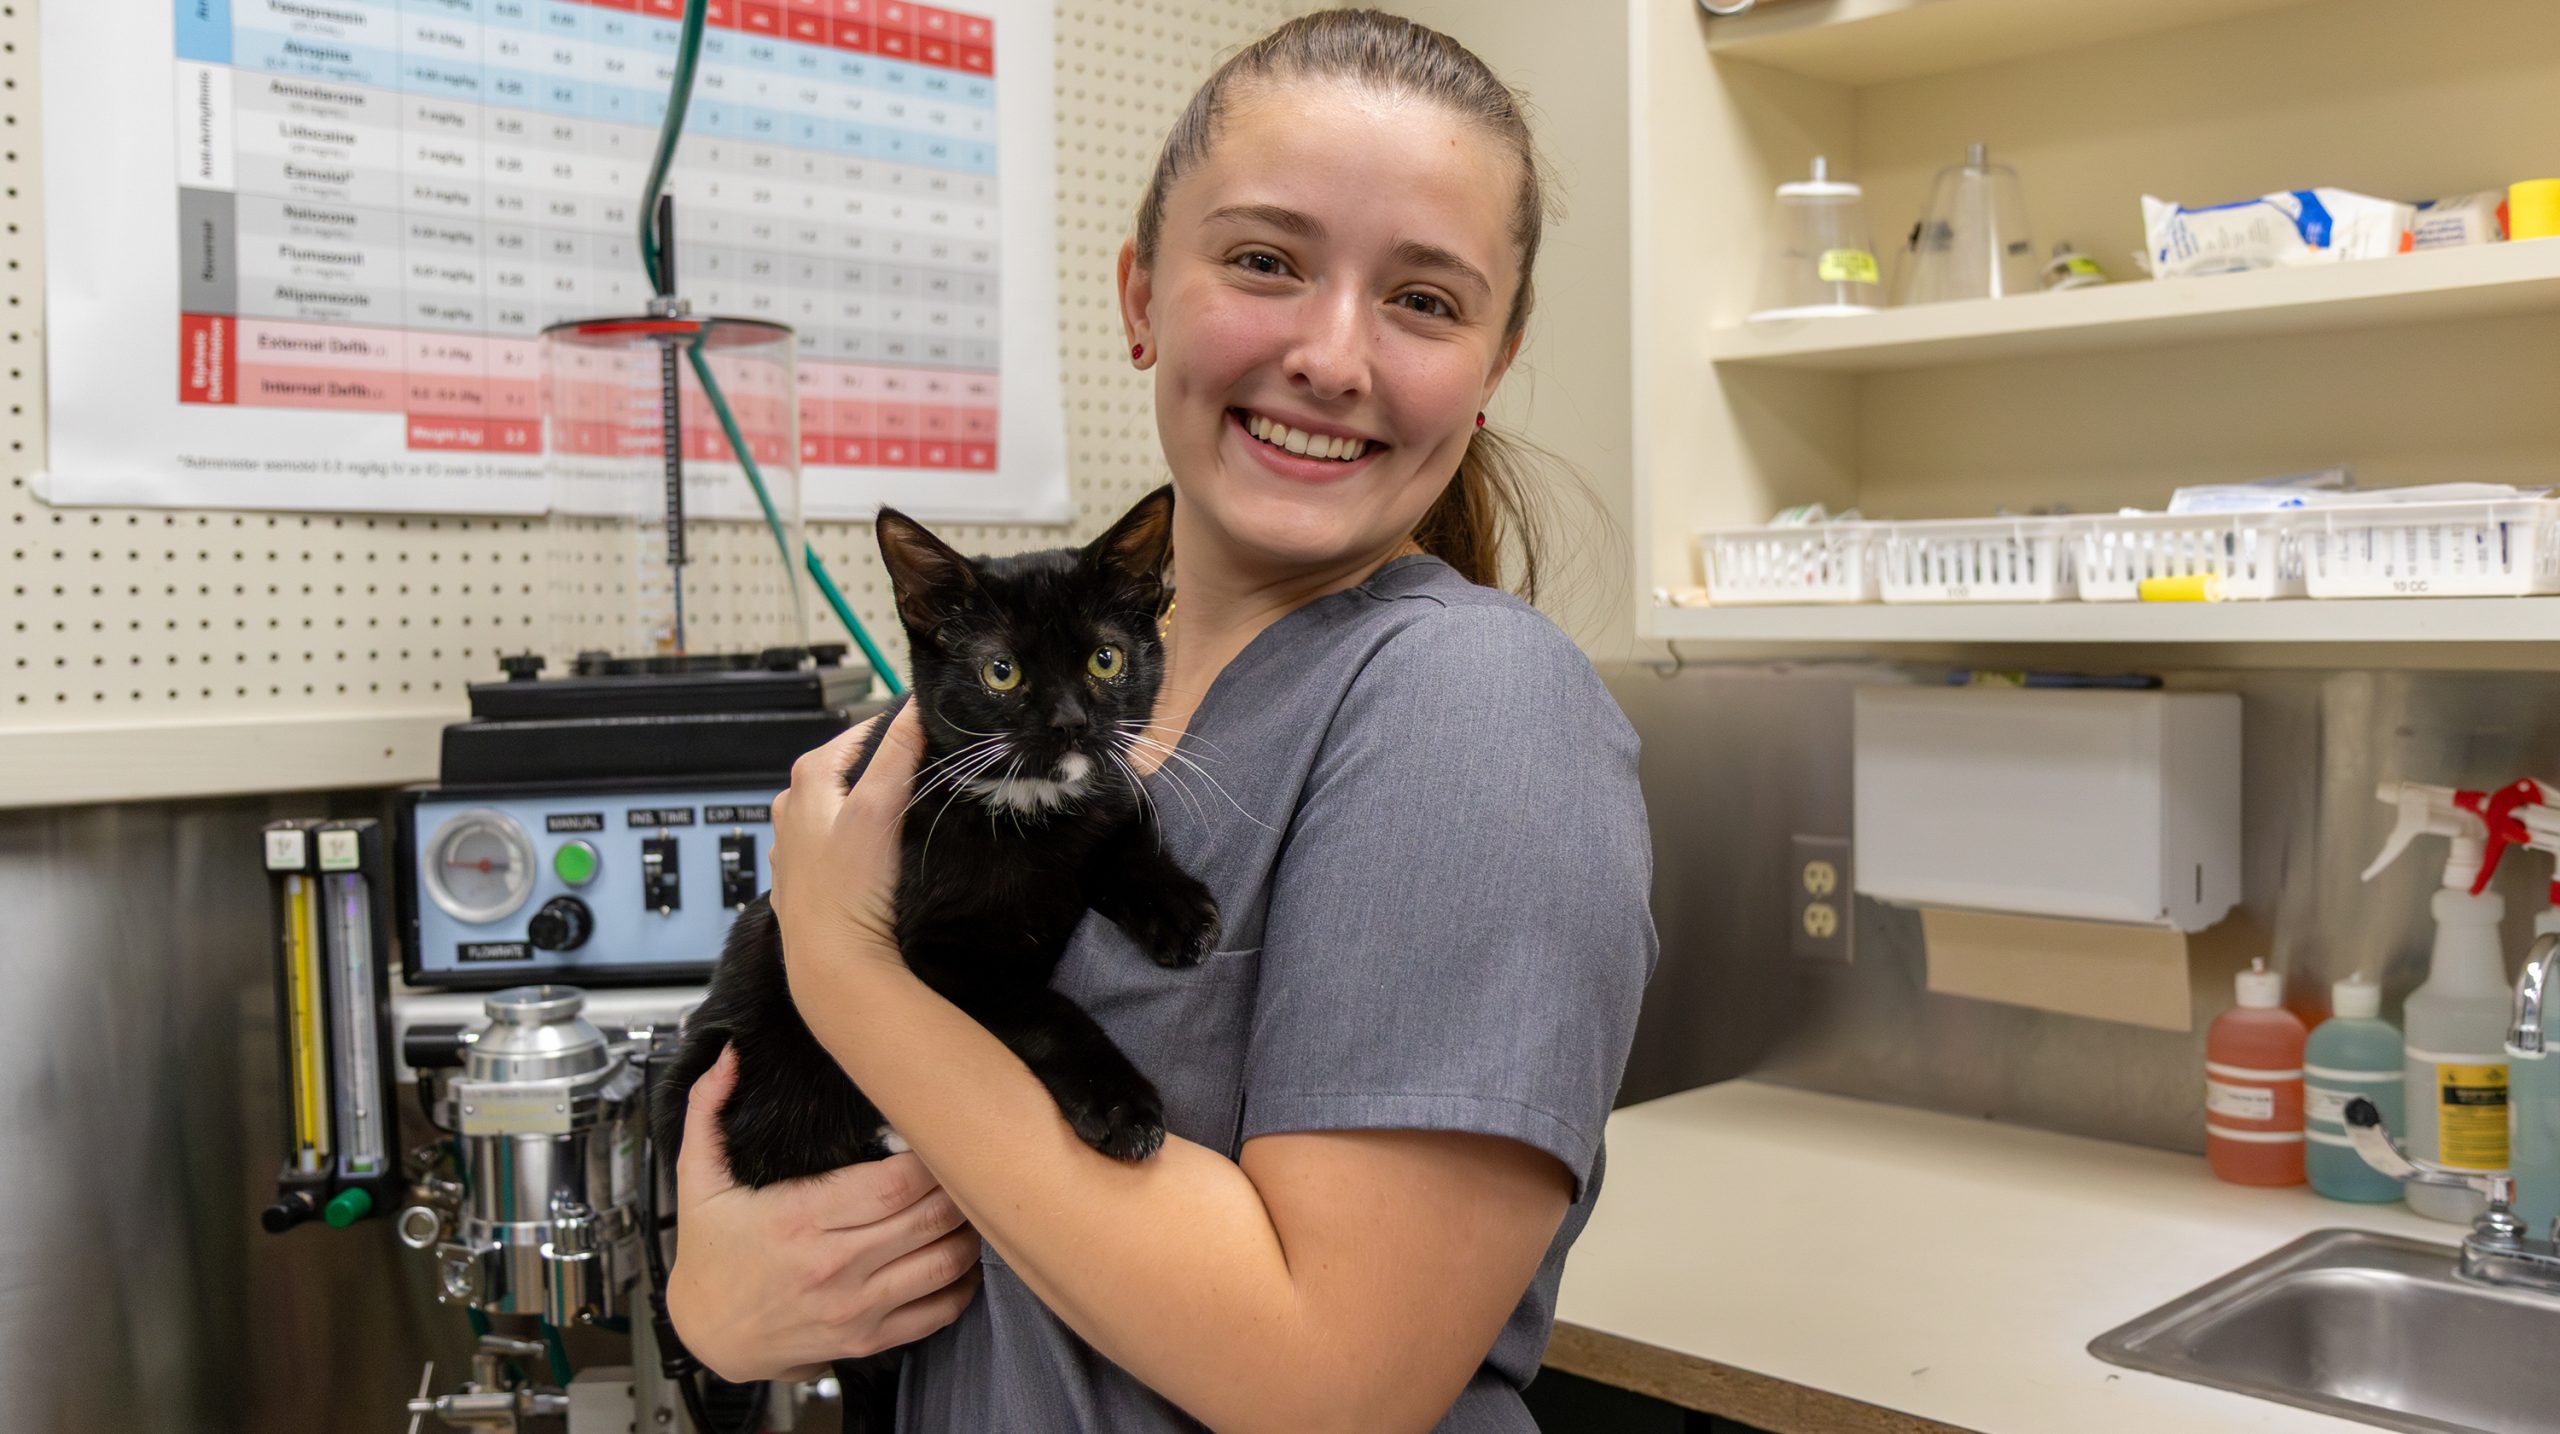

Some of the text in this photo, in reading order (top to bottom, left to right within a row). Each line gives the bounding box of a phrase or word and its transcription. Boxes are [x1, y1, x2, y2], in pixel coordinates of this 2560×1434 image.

[283, 39, 352, 62] Atropine
[270, 79, 367, 104] Amiodarone
[279, 121, 357, 146] Lidocaine
[283, 204, 358, 227] Naloxone
[257, 333, 326, 353] External
[260, 379, 325, 397] Internal
[548, 815, 601, 831] MANUAL
[659, 810, 691, 825] TIME
[736, 808, 768, 822] TIME
